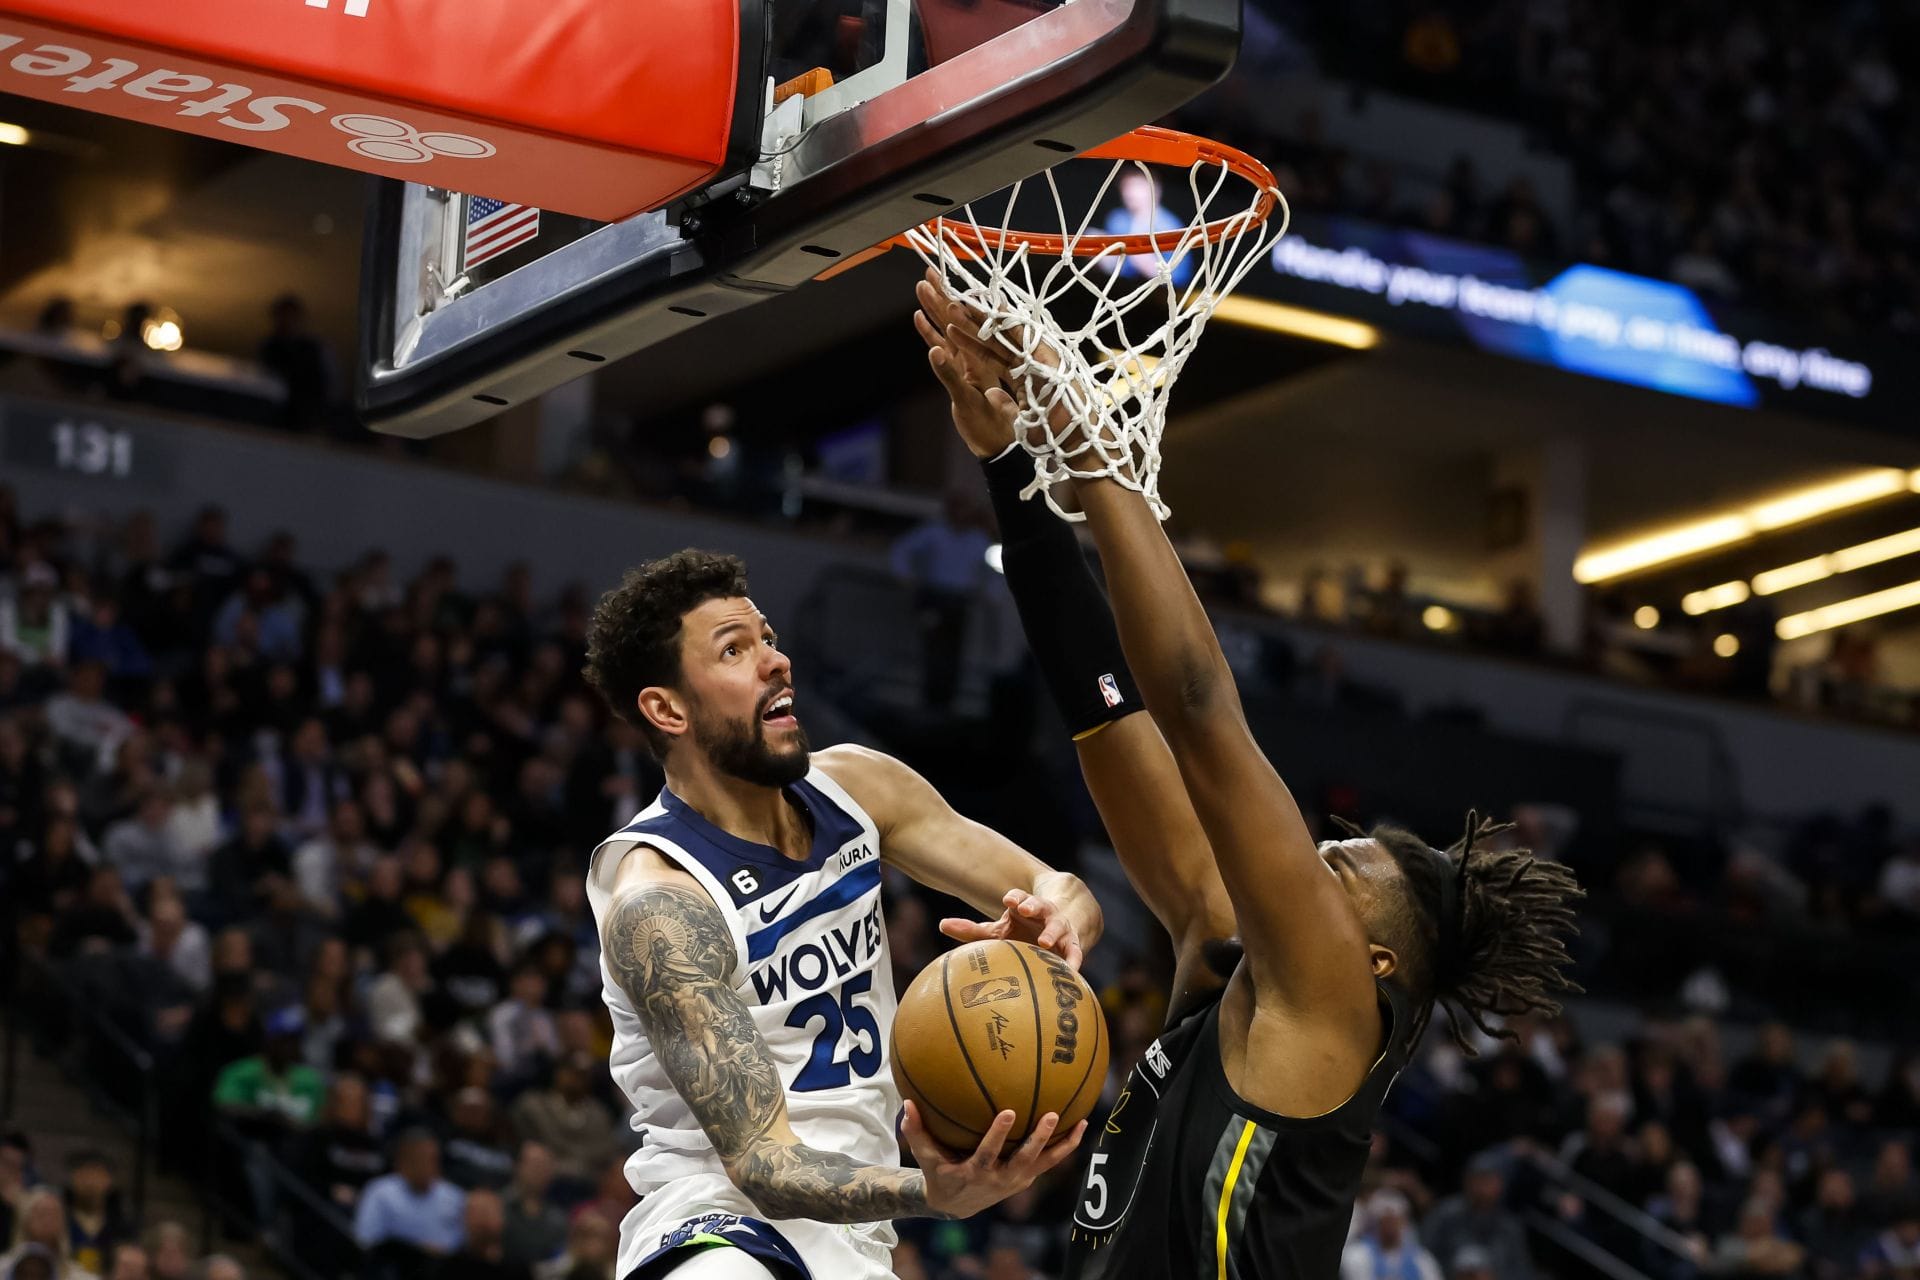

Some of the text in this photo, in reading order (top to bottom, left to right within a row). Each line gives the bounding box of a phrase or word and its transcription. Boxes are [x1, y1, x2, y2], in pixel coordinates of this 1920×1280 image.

[10, 44, 327, 131] State
[1387, 264, 1459, 307] your
[54, 421, 133, 477] 131
[731, 868, 760, 896] 6
[750, 898, 882, 1005] WOLVES
[783, 969, 883, 1092] 25
[1084, 1152, 1109, 1220] 5
